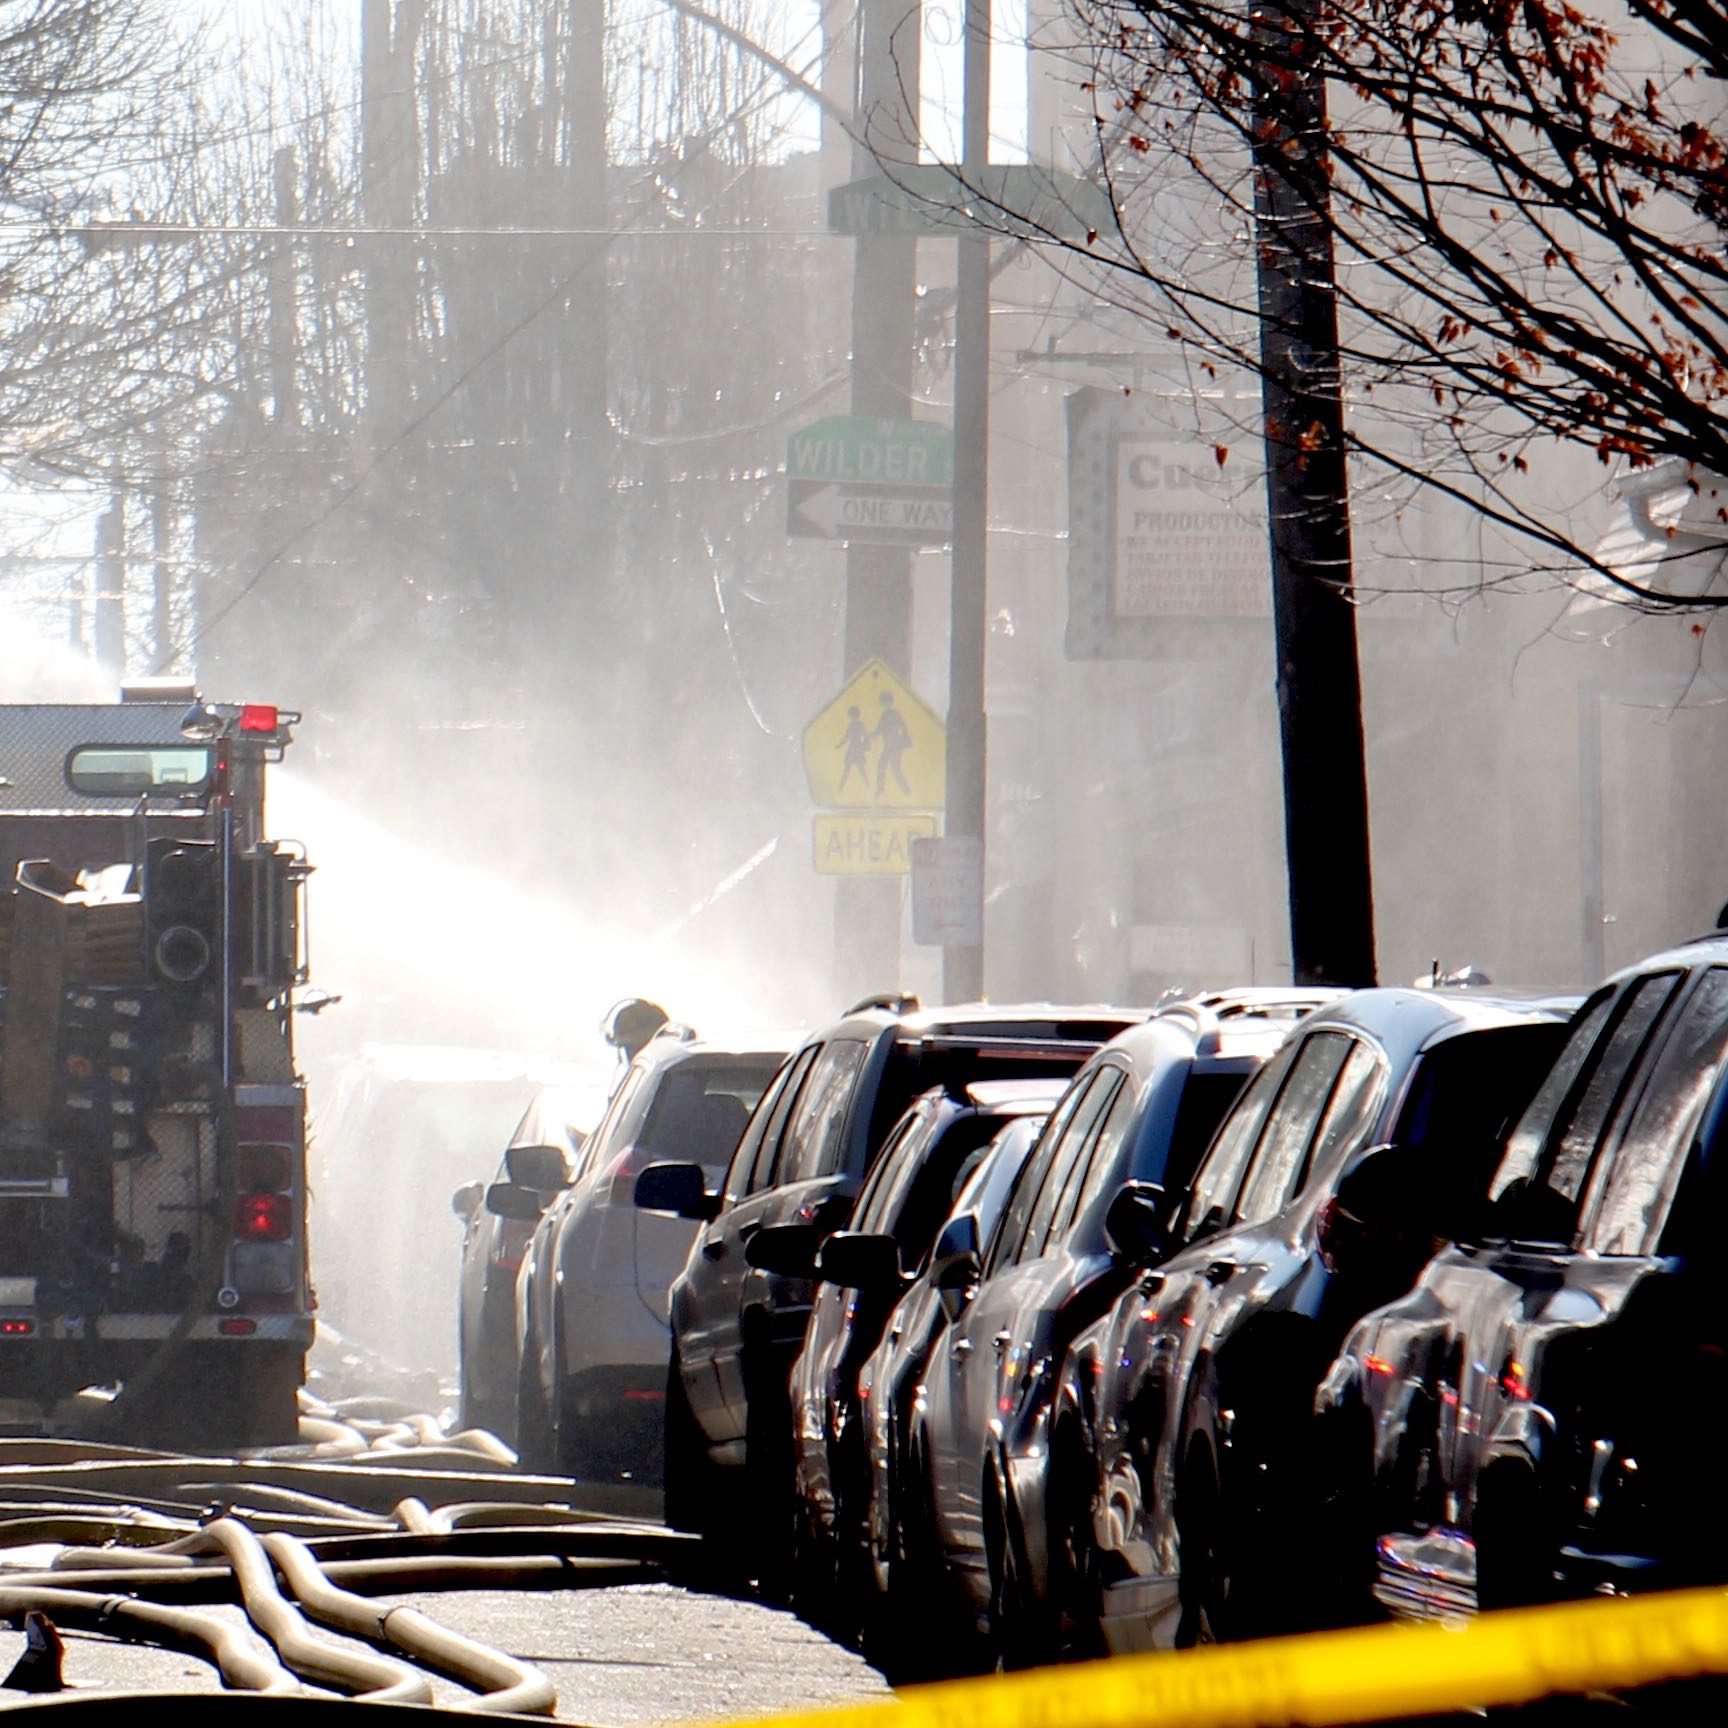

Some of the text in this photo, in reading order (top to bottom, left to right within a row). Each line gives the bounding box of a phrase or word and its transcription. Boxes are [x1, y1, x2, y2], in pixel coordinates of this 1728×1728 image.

[793, 437, 929, 480] WILDER
[842, 499, 954, 527] ONE WAY
